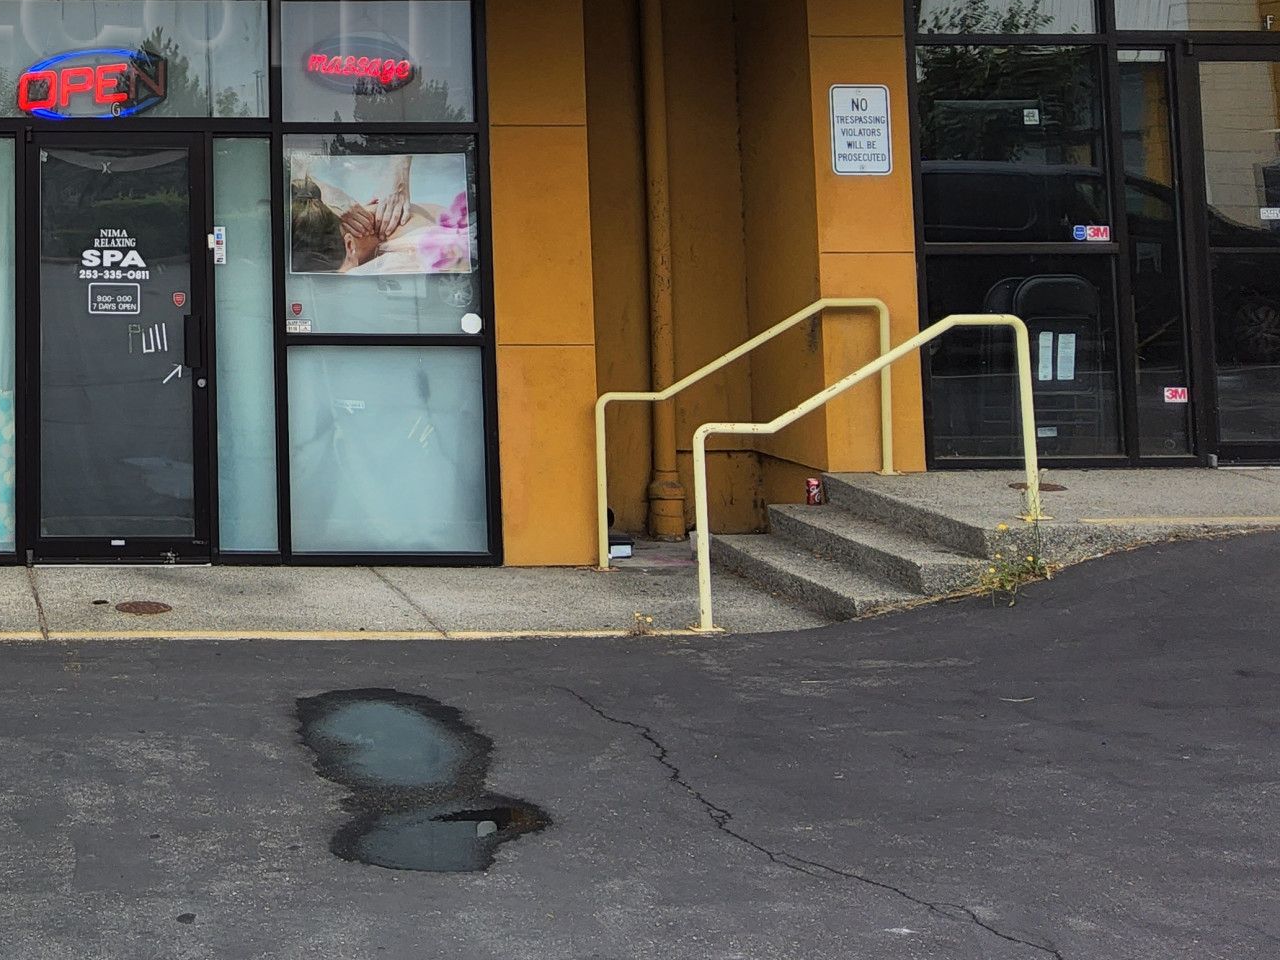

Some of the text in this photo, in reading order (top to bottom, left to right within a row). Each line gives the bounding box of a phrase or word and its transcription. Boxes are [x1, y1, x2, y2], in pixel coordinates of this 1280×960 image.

[18, 59, 166, 111] OPEN
[111, 102, 121, 117] G
[851, 98, 868, 111] NO
[836, 115, 886, 125] TRESPASSING
[841, 128, 881, 137] VIOLATORS
[846, 140, 877, 150] WILL BE
[838, 153, 887, 162] PROSECUTED
[100, 229, 128, 238] NIMA
[1088, 226, 1108, 239] 3M
[94, 238, 136, 248] RELAXING
[81, 249, 147, 268] SPA
[79, 269, 150, 280] 253-335-0811
[1166, 389, 1186, 400] 3M
